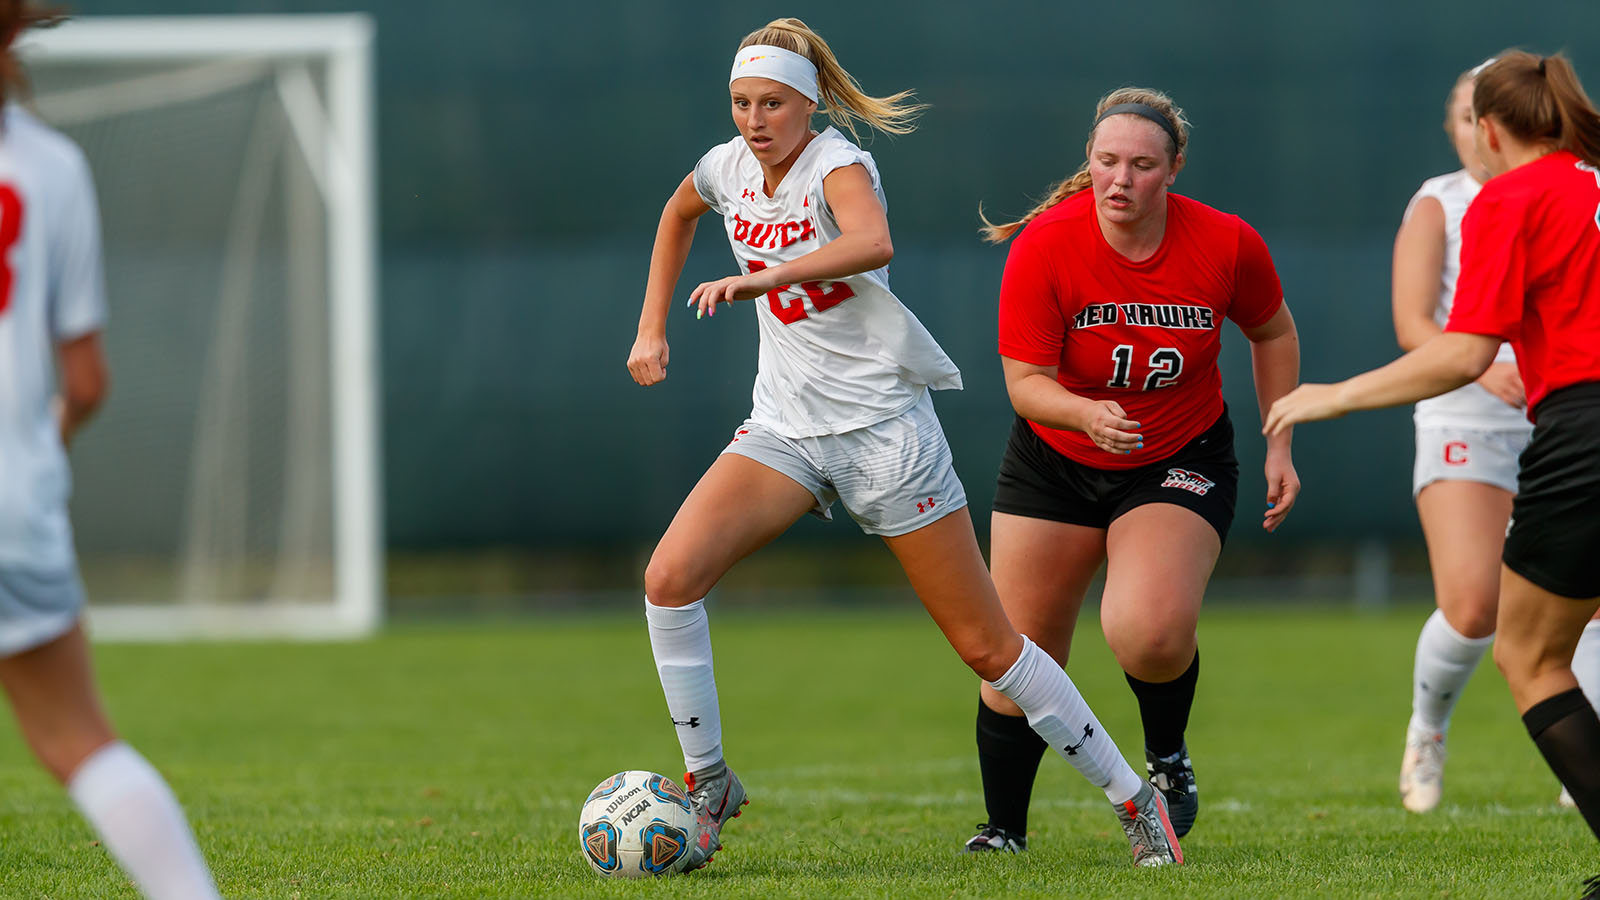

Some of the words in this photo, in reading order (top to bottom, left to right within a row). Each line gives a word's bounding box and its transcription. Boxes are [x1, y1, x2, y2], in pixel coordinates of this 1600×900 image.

[733, 213, 817, 249] DUTCH
[1118, 303, 1215, 330] HAWKS
[1106, 344, 1184, 391] 12
[1444, 441, 1468, 465] C
[605, 786, 642, 814] Wilson
[621, 799, 652, 827] NCAA
